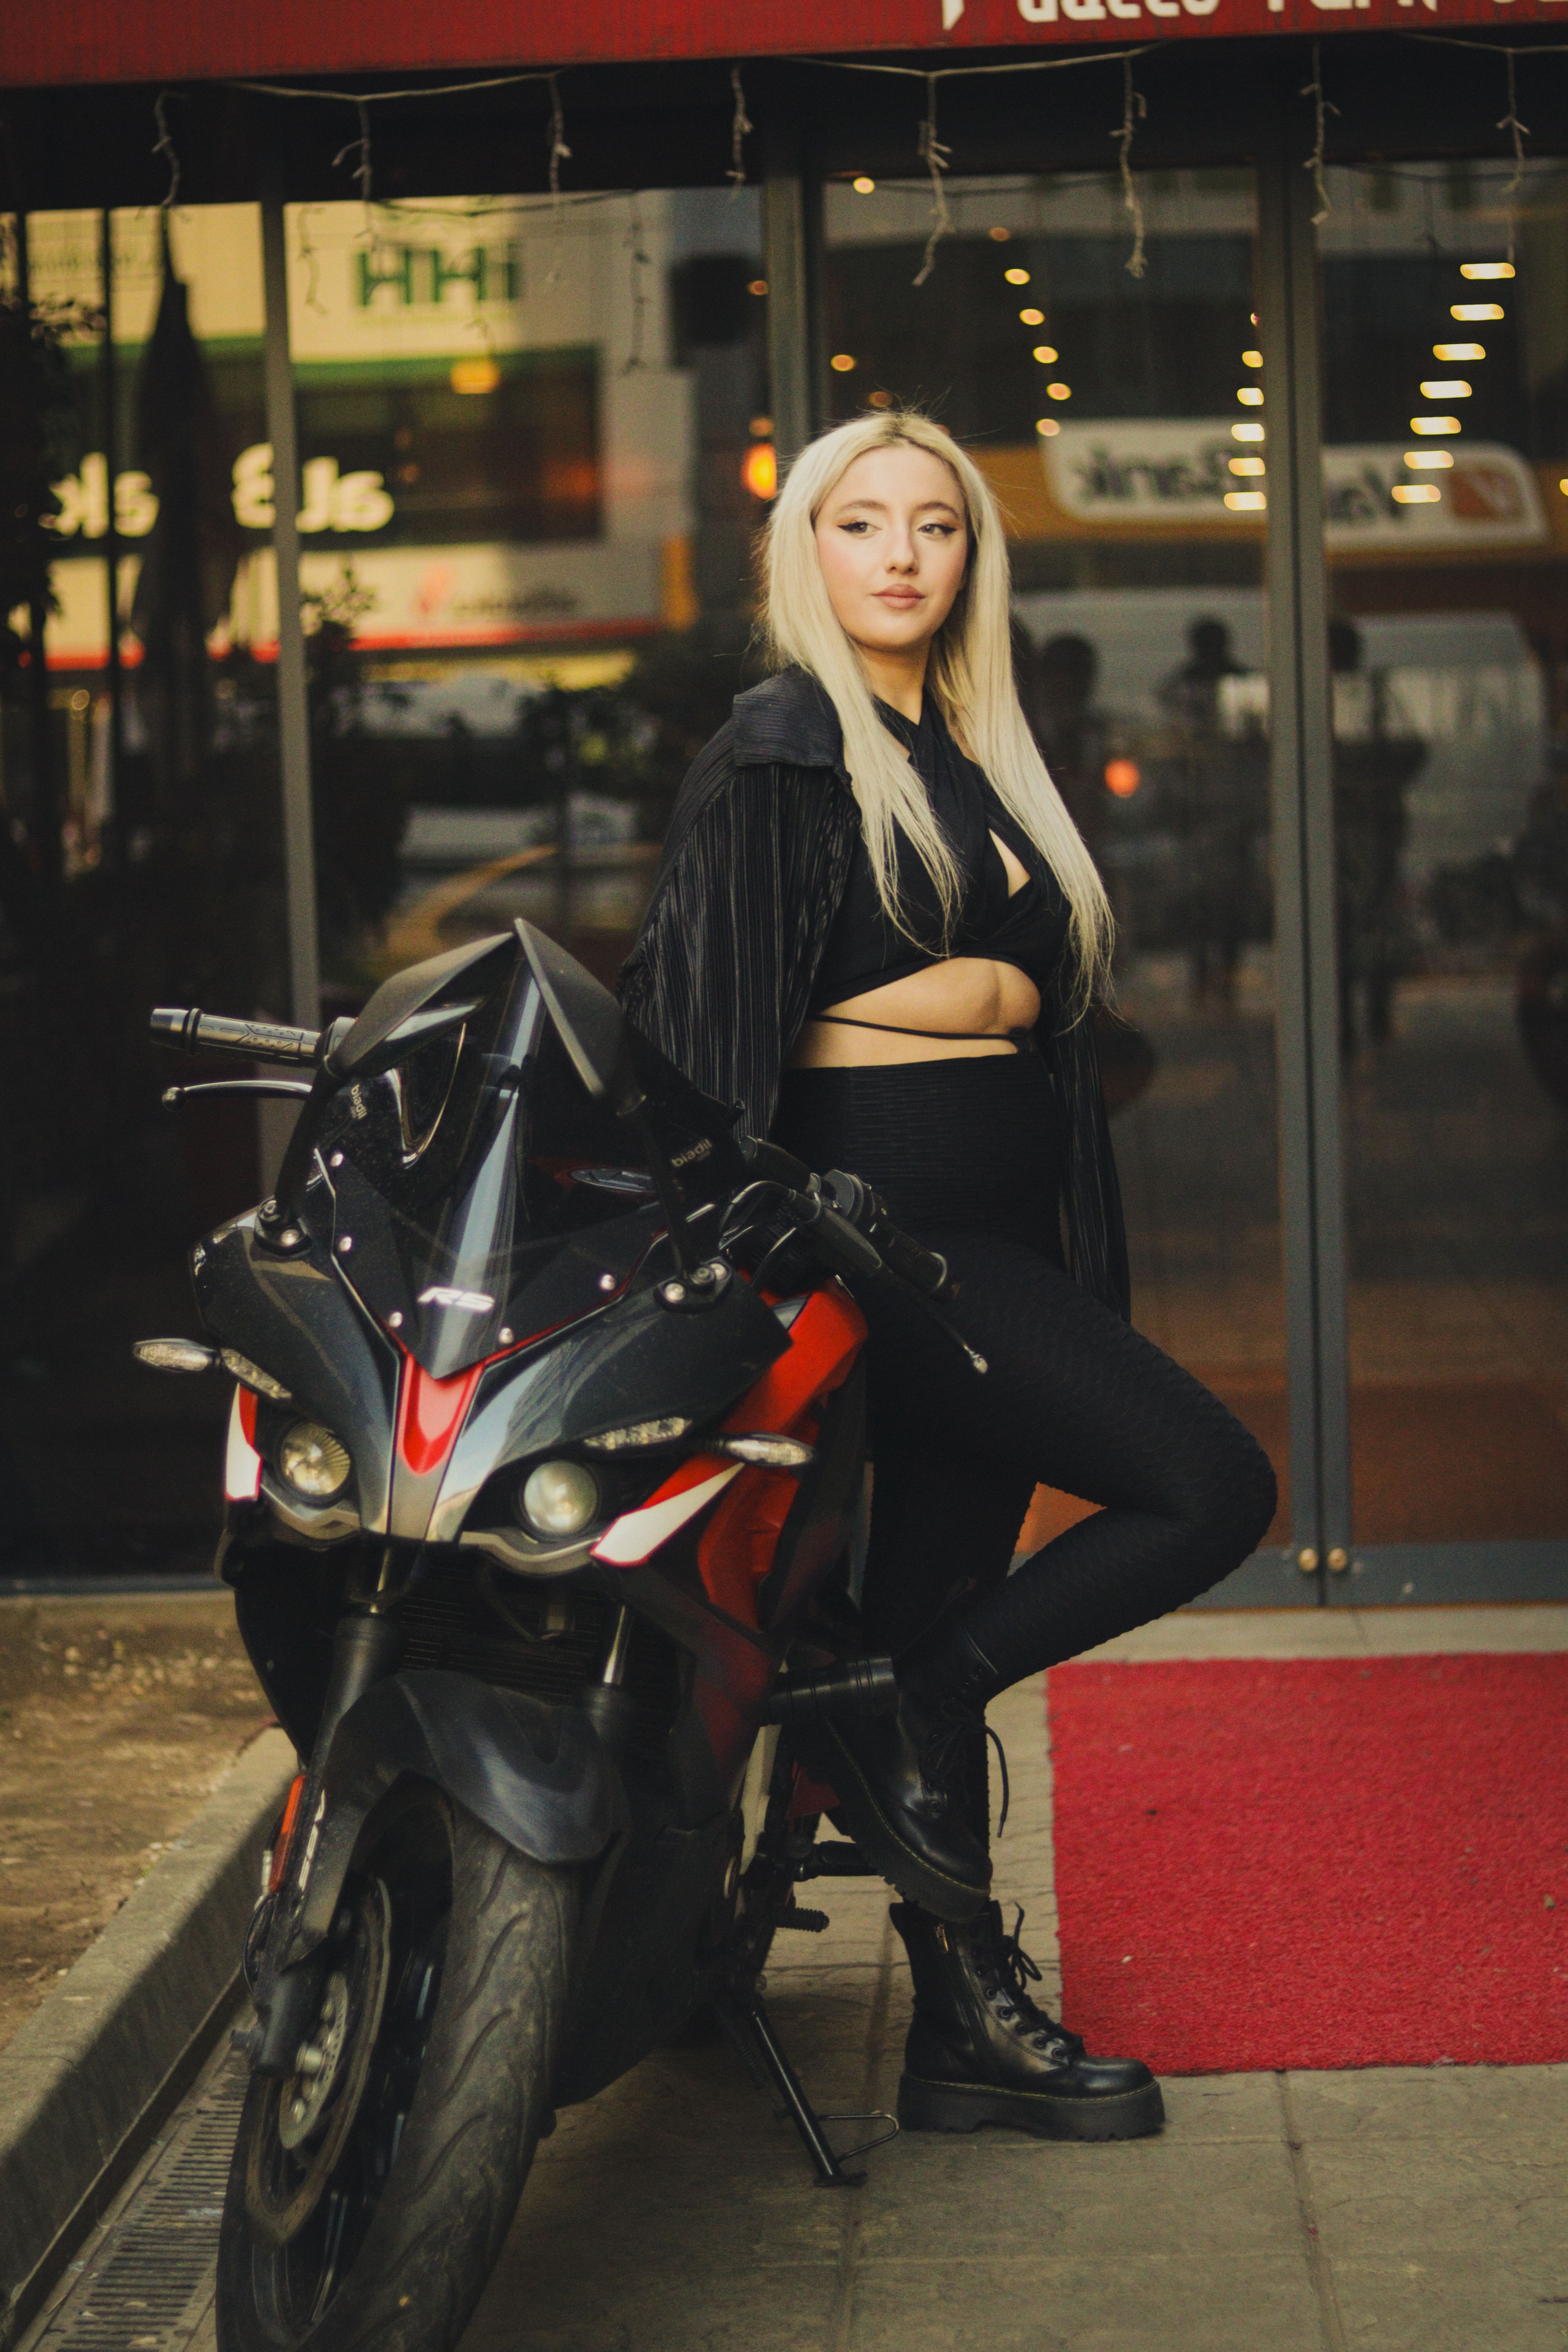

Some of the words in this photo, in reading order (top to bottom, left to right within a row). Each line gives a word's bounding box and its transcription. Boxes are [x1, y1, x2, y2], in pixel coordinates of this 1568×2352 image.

[351, 1084, 367, 1119] biadil
[671, 1138, 712, 1167] biadil
[417, 1286, 495, 1311] RS
